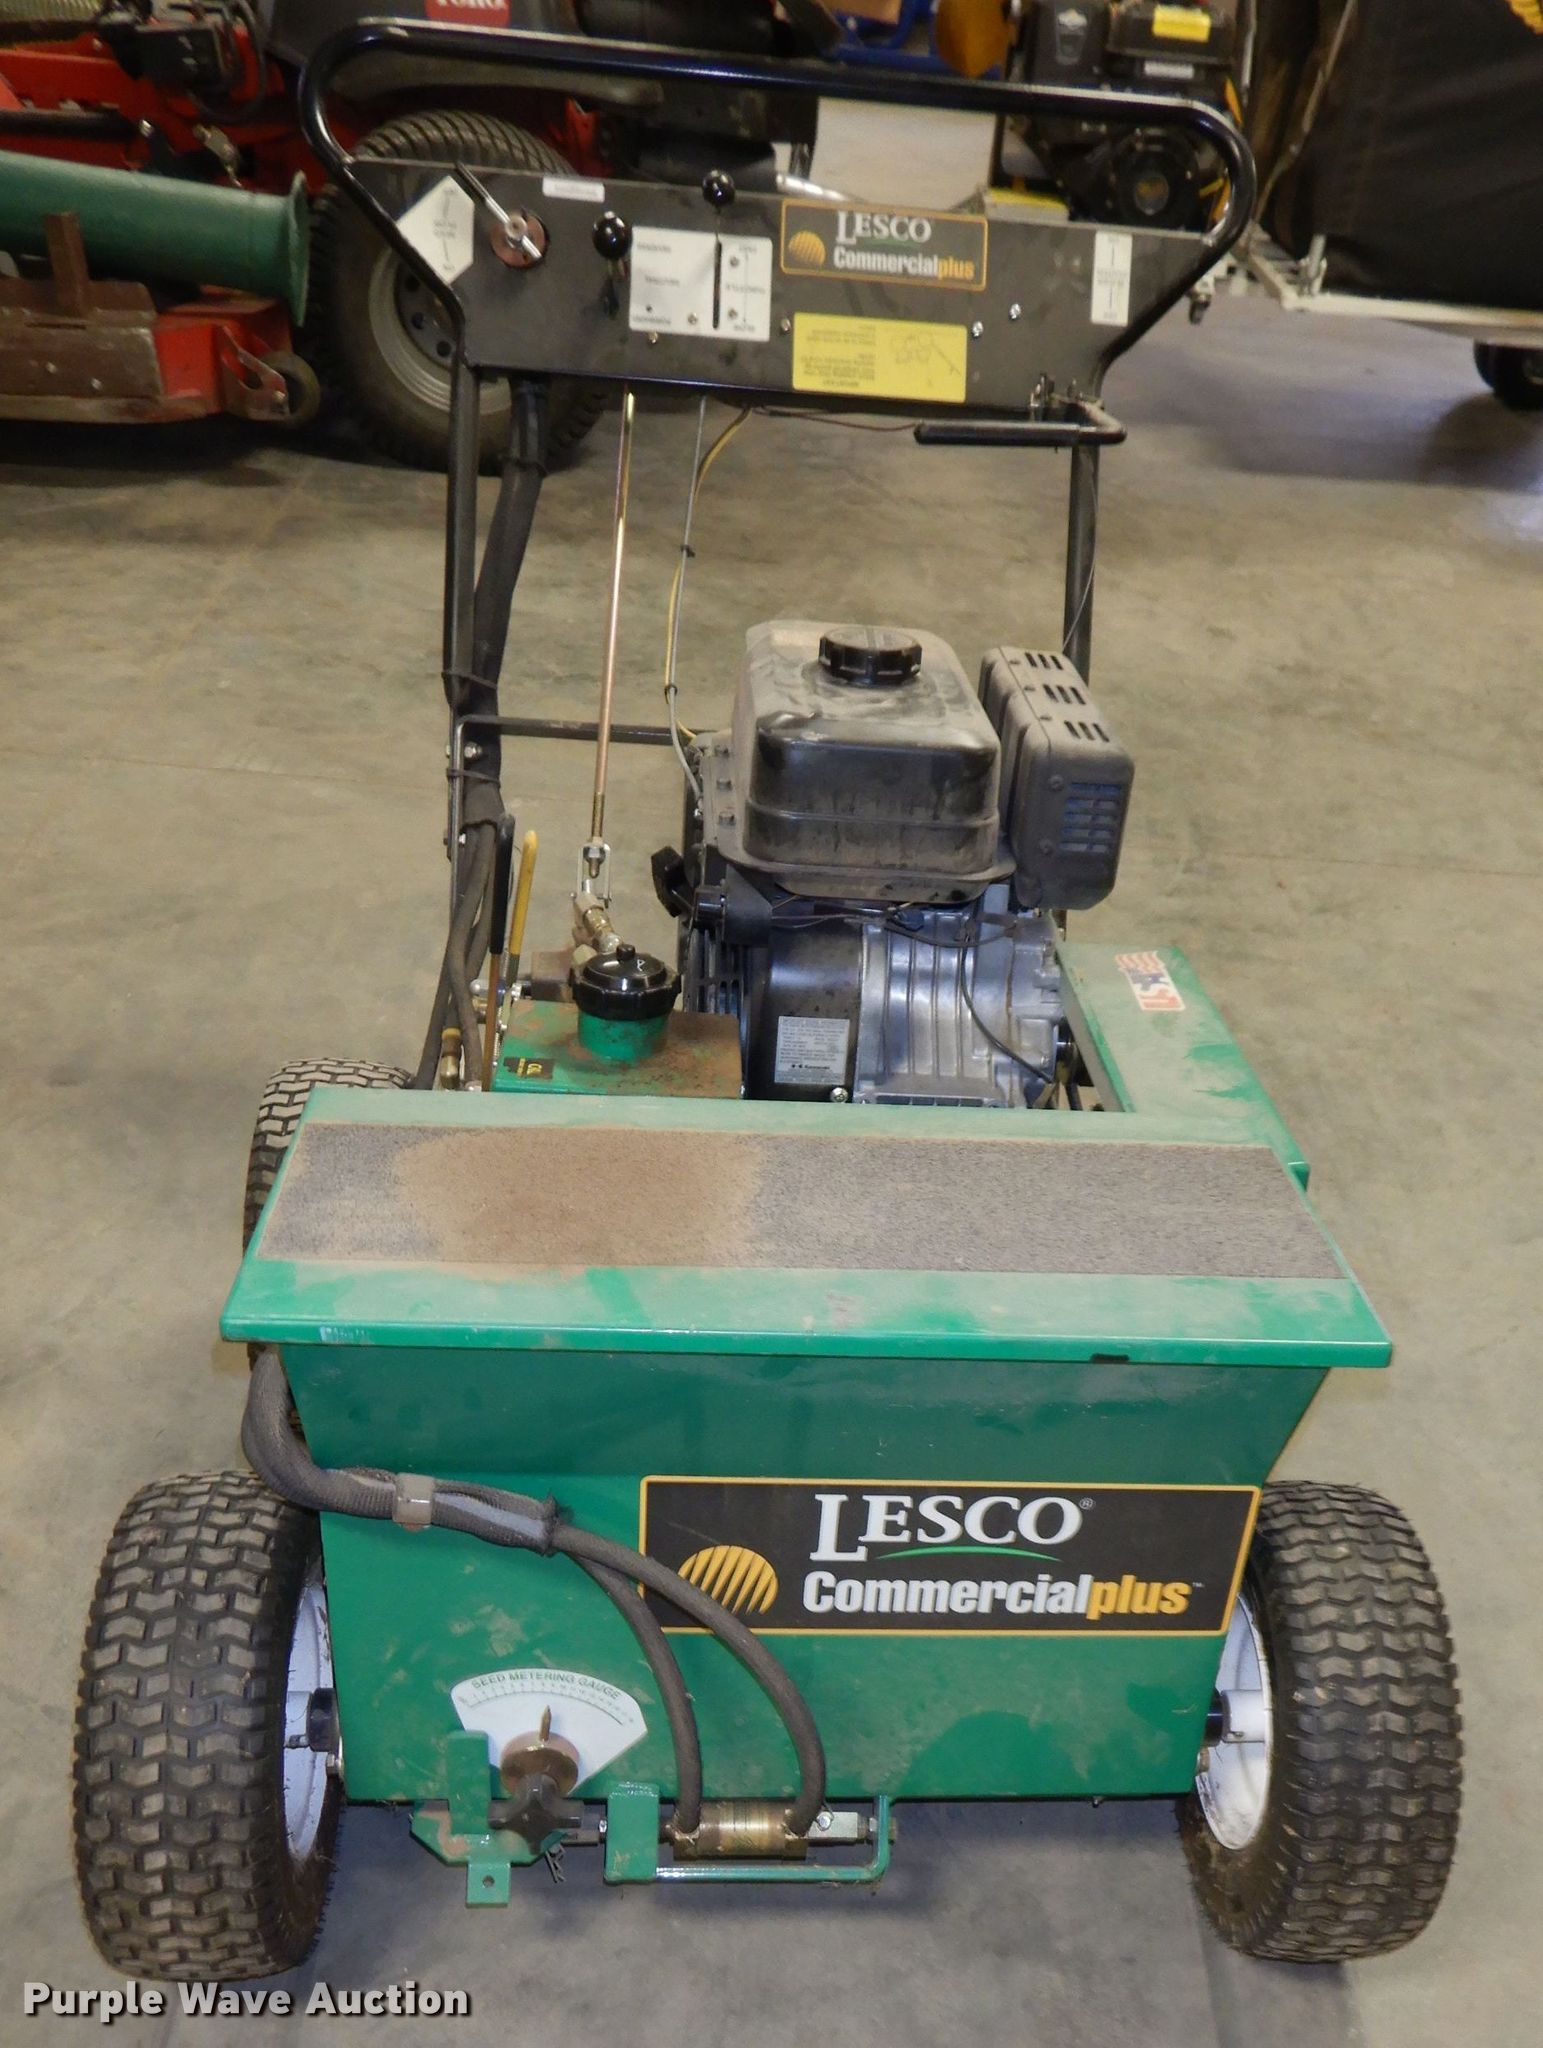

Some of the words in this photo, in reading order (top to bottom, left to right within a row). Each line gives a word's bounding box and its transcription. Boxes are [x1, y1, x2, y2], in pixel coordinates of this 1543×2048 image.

[835, 209, 932, 245] LESCO
[471, 1671, 506, 1689] SEED
[509, 1671, 575, 1685] METERING
[577, 1676, 623, 1700] GAUGE
